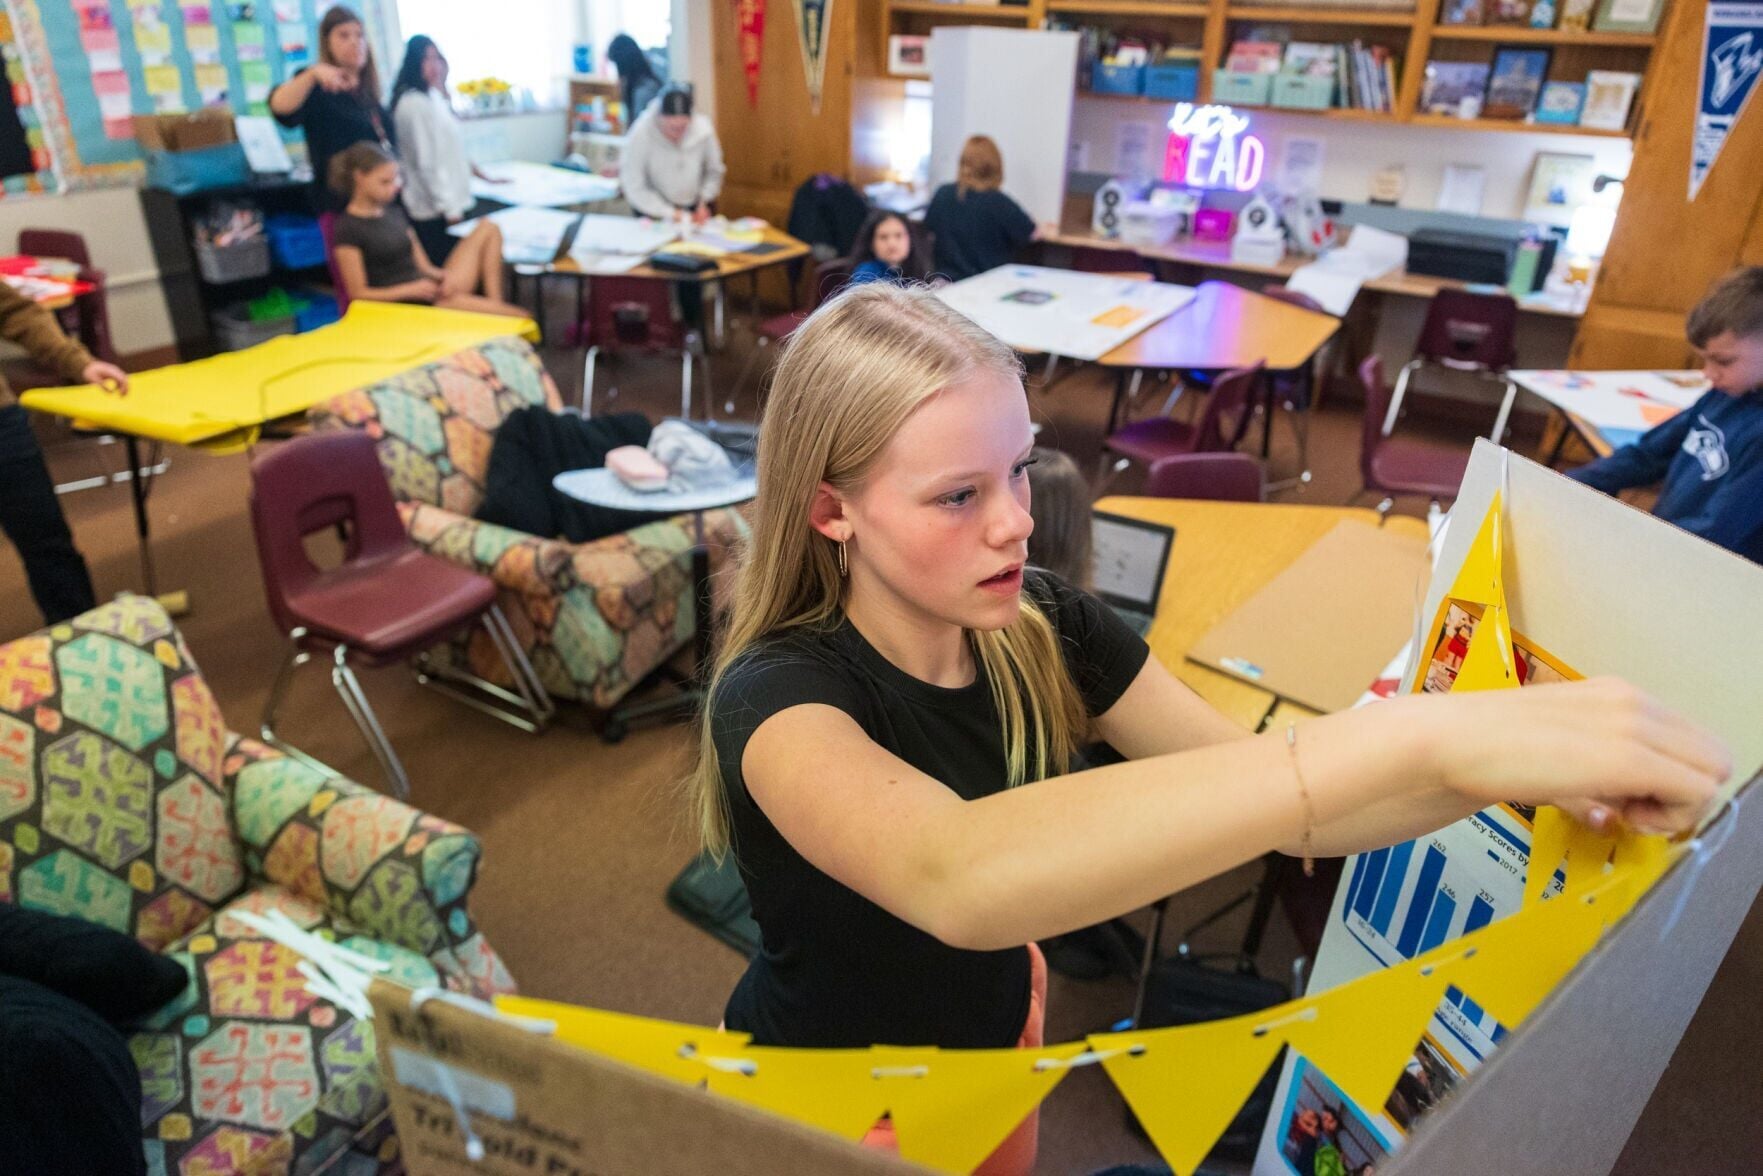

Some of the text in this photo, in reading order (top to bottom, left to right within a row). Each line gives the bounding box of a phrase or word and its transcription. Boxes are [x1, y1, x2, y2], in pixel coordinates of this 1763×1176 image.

[1163, 131, 1265, 192] READ
[1432, 838, 1448, 853] 262
[1469, 816, 1530, 867] racy Scores by
[1500, 859, 1518, 875] 2017
[1442, 882, 1457, 899] 246
[1479, 888, 1495, 904] 257
